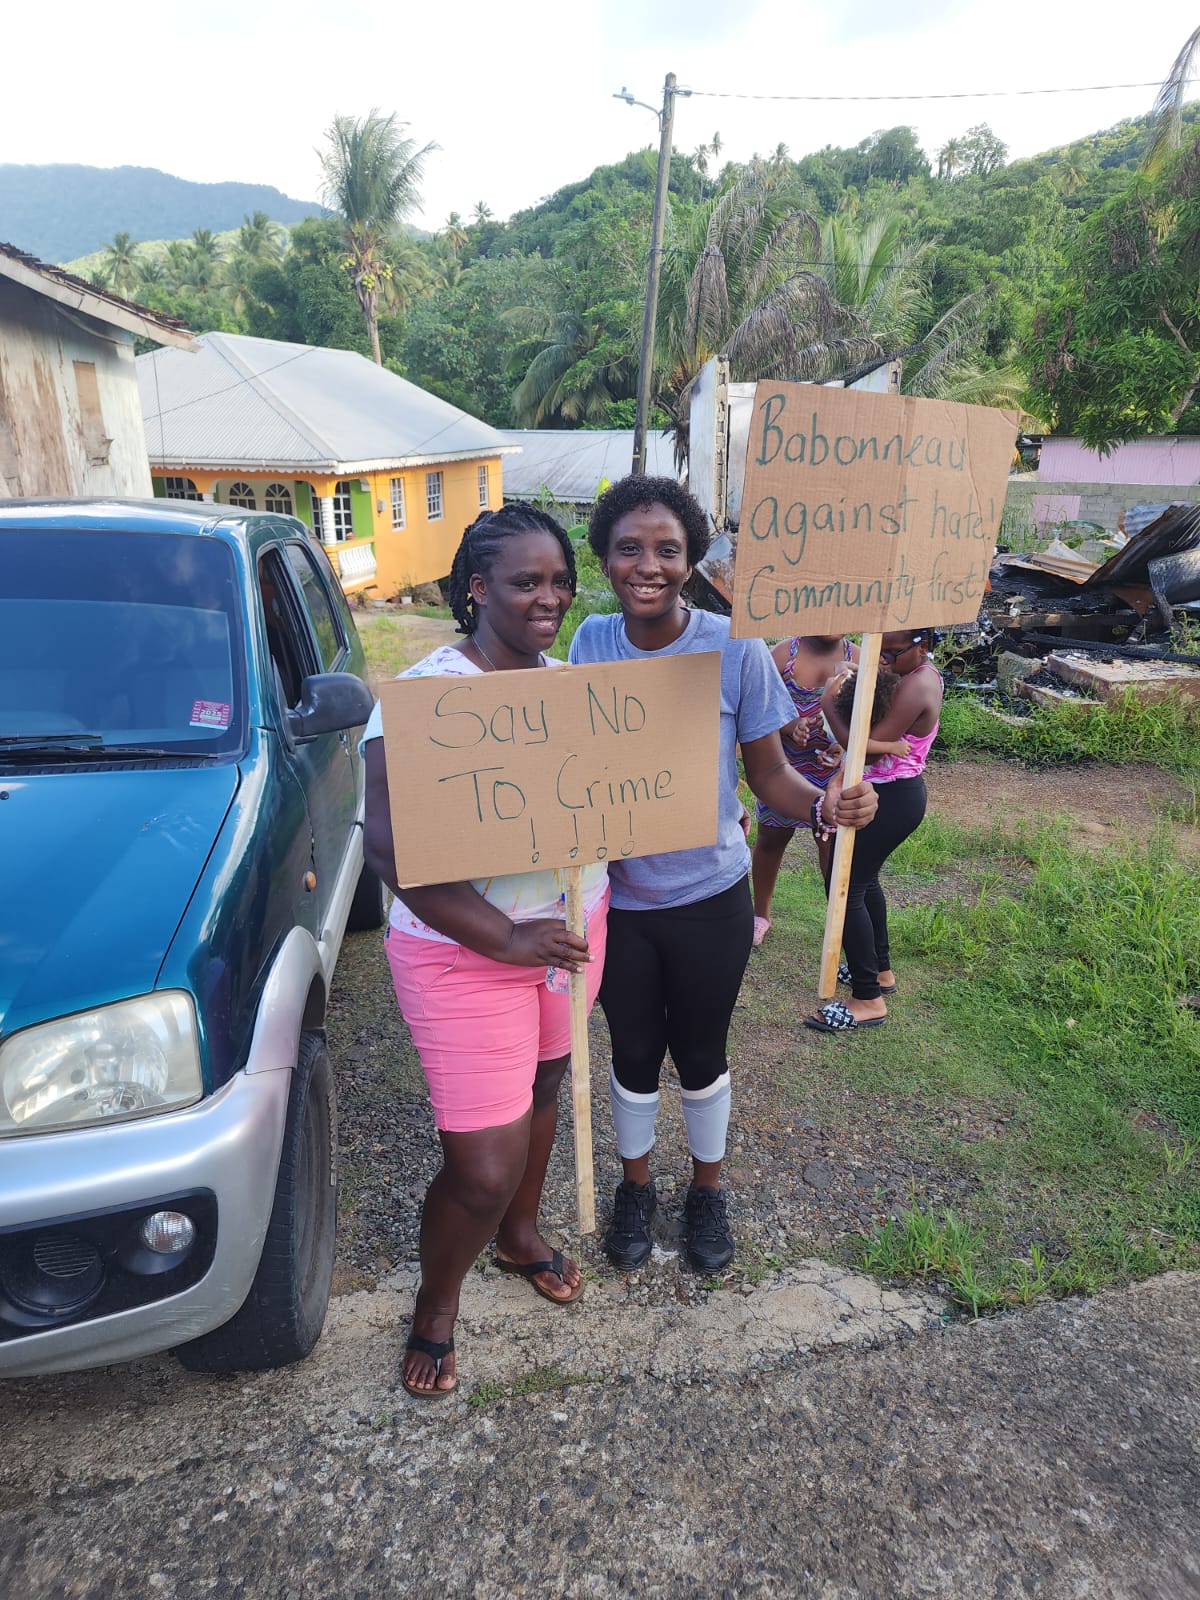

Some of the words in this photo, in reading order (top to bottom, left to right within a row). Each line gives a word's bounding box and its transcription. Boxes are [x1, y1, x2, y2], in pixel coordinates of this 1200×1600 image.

[756, 393, 966, 471] Babonneau
[930, 488, 996, 541] hate!
[747, 555, 915, 624] Community
[928, 550, 989, 606] first!
[429, 686, 549, 749] Say
[587, 681, 646, 736] No
[556, 753, 676, 810] Crime
